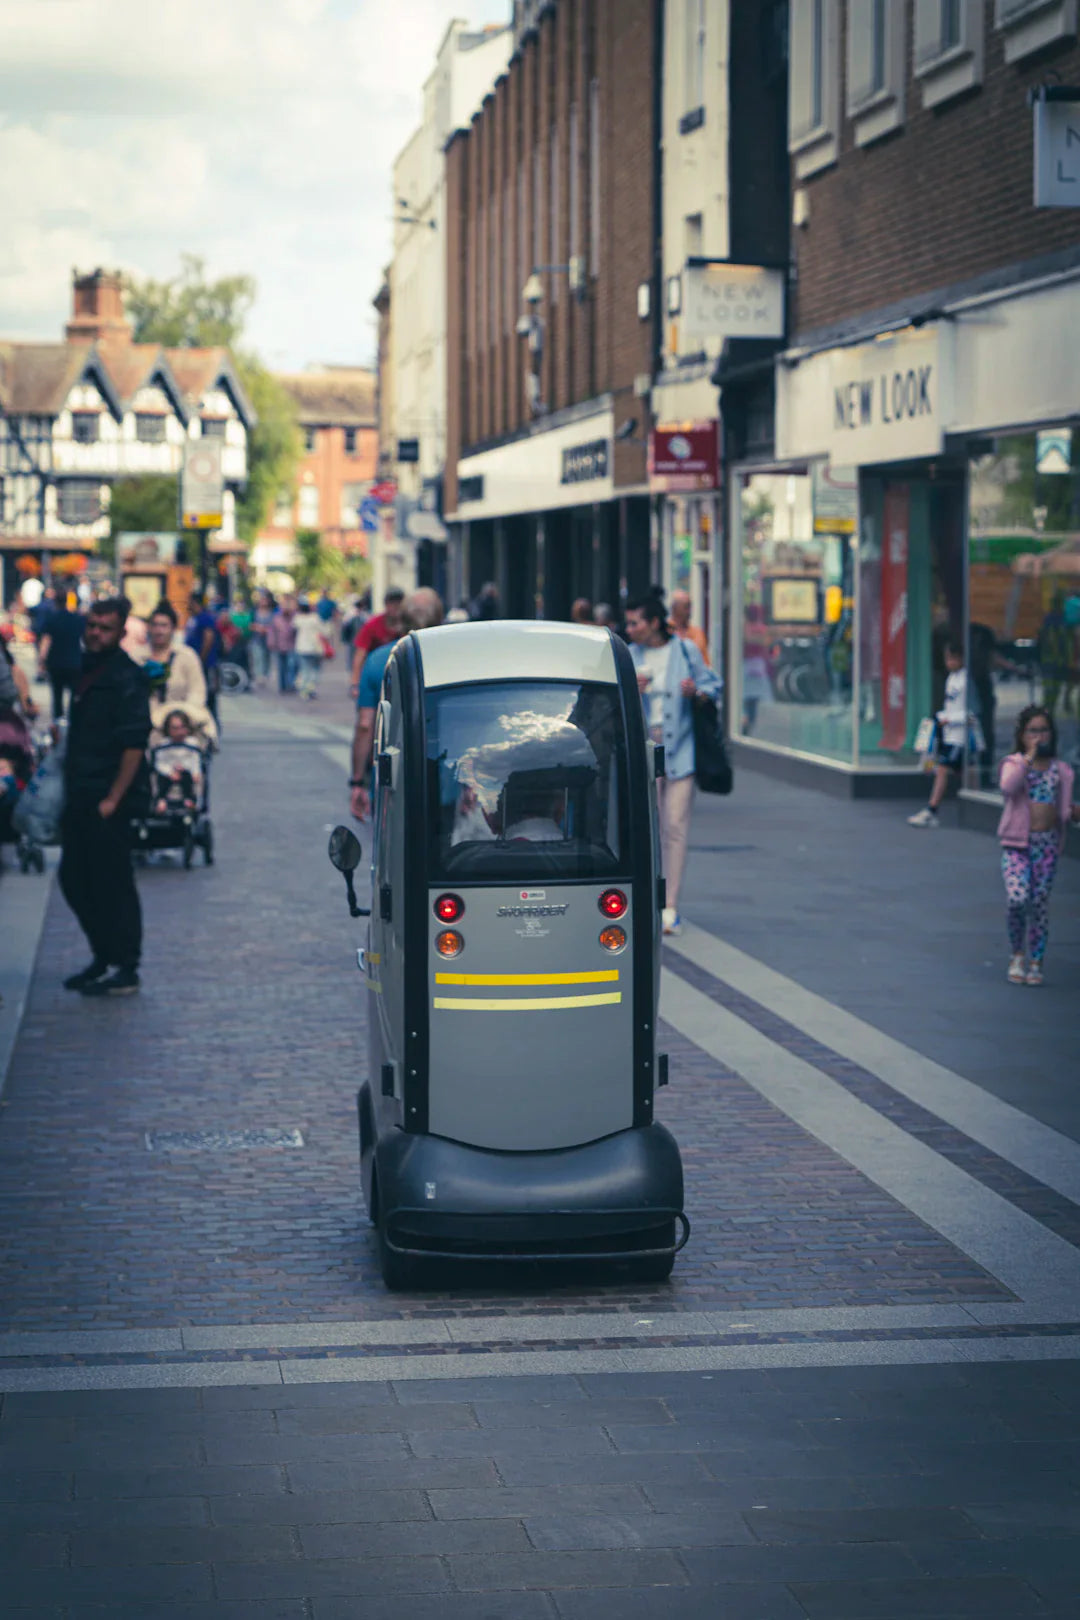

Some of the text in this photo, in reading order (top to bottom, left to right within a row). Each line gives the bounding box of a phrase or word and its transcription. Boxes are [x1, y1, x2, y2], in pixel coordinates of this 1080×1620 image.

[701, 283, 766, 300] NEW
[697, 304, 771, 322] LOOK
[833, 365, 932, 430] NEW LOOK
